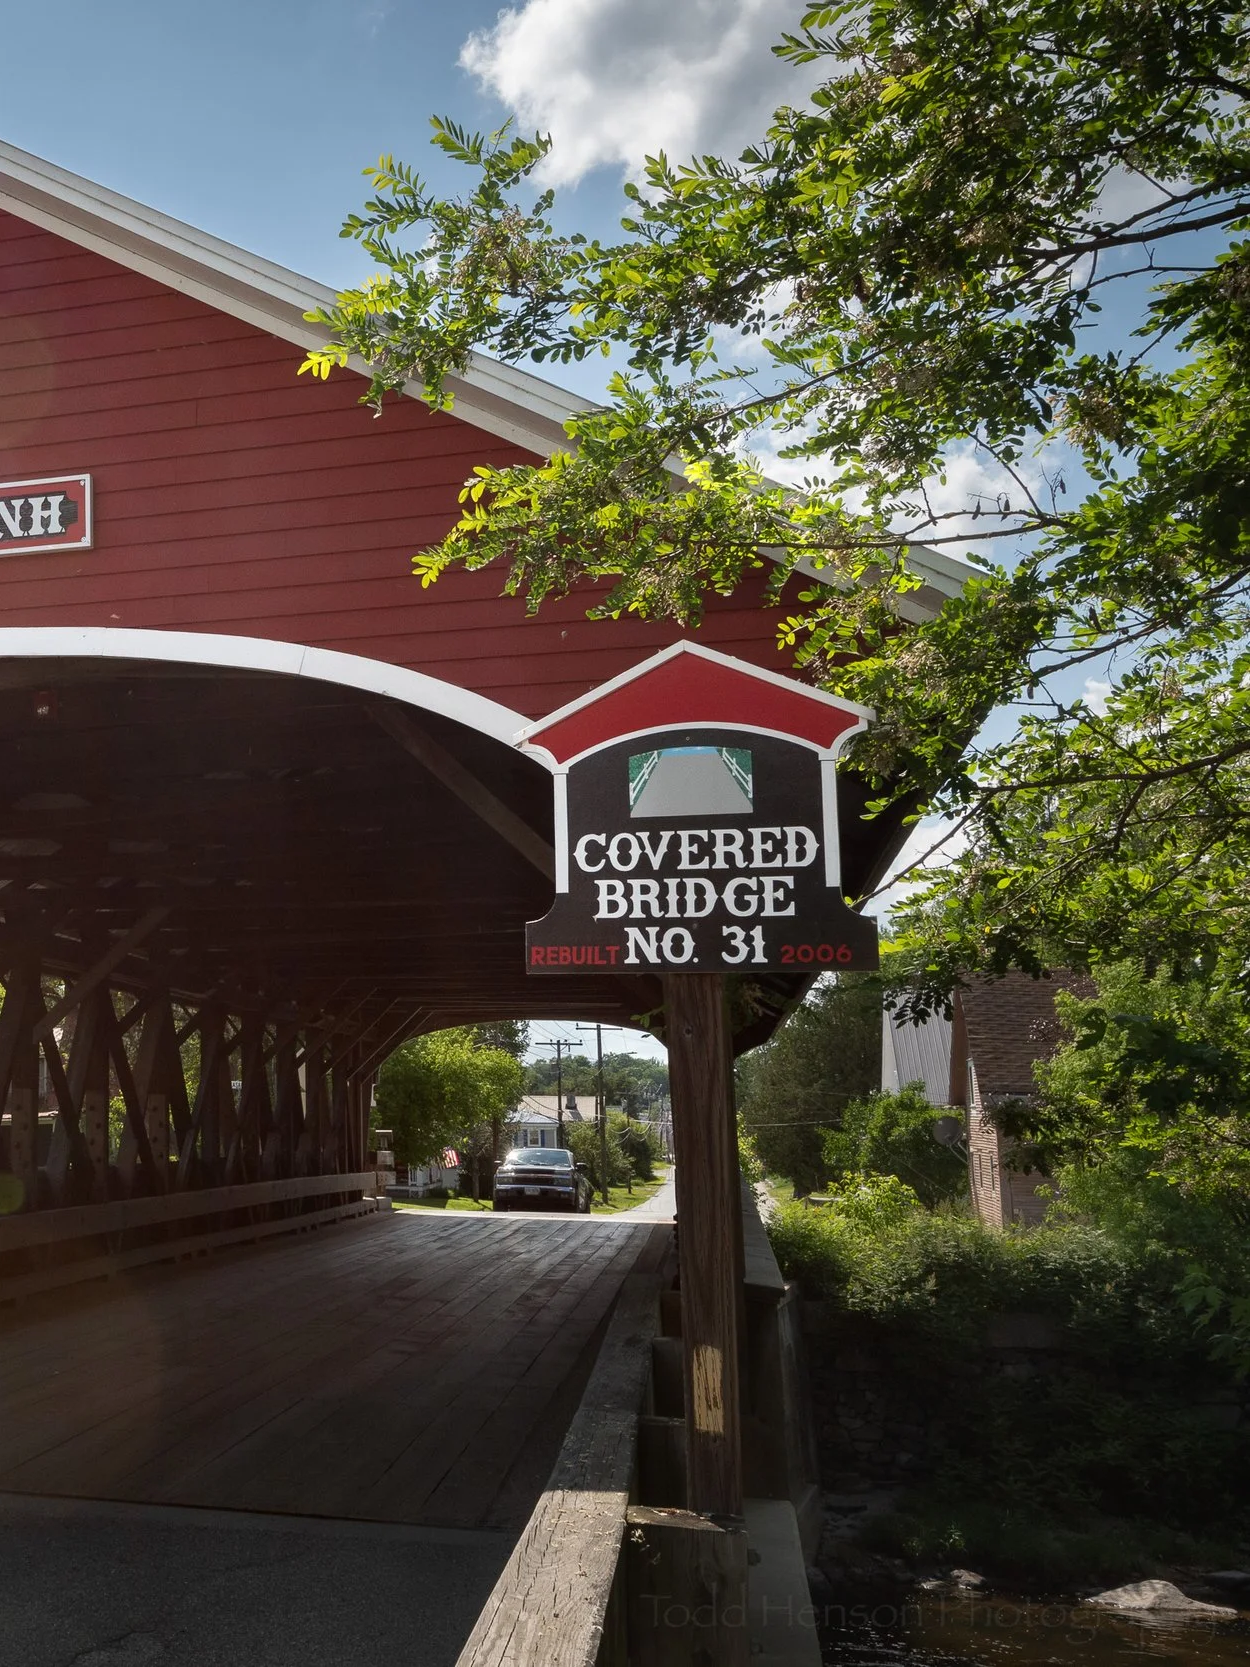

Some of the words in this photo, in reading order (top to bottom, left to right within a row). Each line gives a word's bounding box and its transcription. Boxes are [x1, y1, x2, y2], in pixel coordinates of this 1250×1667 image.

[573, 825, 820, 873] COVERED
[593, 875, 795, 920] BRIDGE
[530, 945, 620, 966] REBUILT
[624, 926, 699, 965] NO.
[721, 924, 769, 964] 31
[780, 943, 852, 964] 2006
